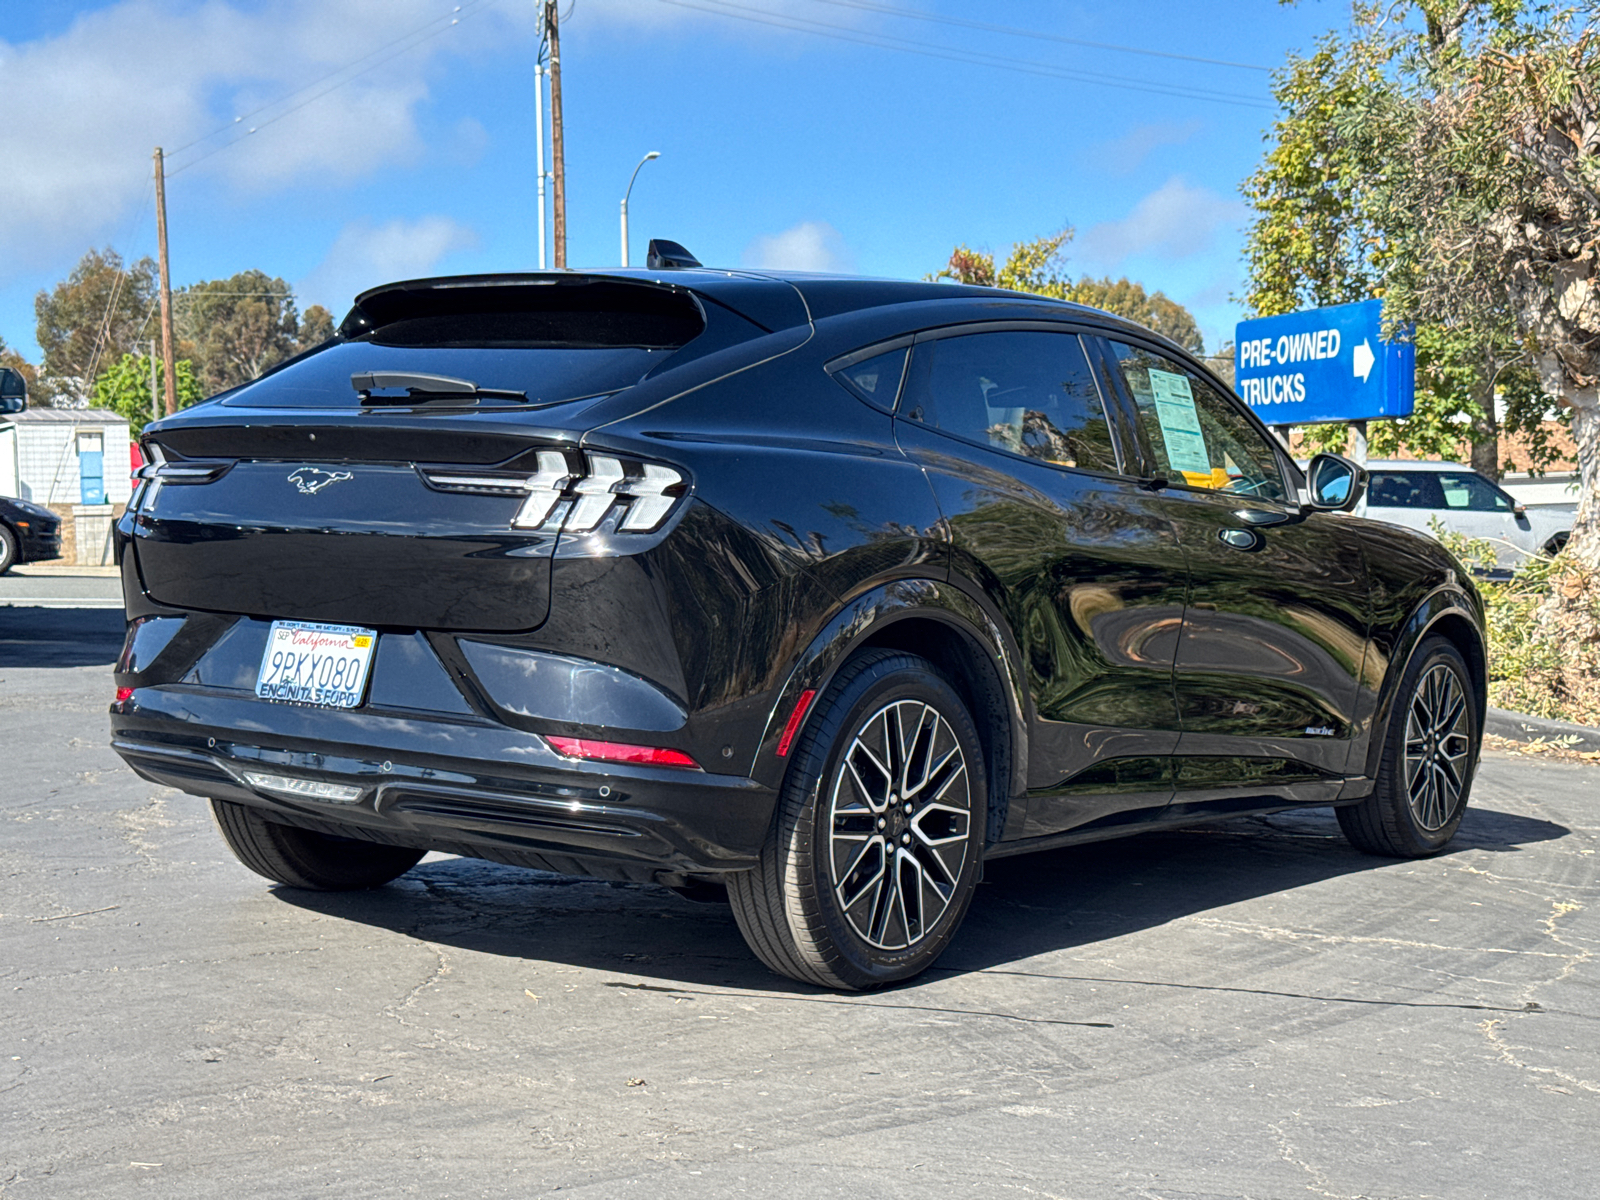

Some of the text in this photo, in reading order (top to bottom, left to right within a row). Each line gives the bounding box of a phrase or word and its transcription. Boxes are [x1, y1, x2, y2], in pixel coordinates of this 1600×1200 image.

[1241, 328, 1340, 369] PRE-OWNED
[1241, 373, 1306, 406] TRUCKS
[277, 630, 290, 641] SEP
[292, 630, 355, 651] California
[267, 651, 360, 691] 9PKX080
[260, 683, 355, 707] ENCINITAS FORD
